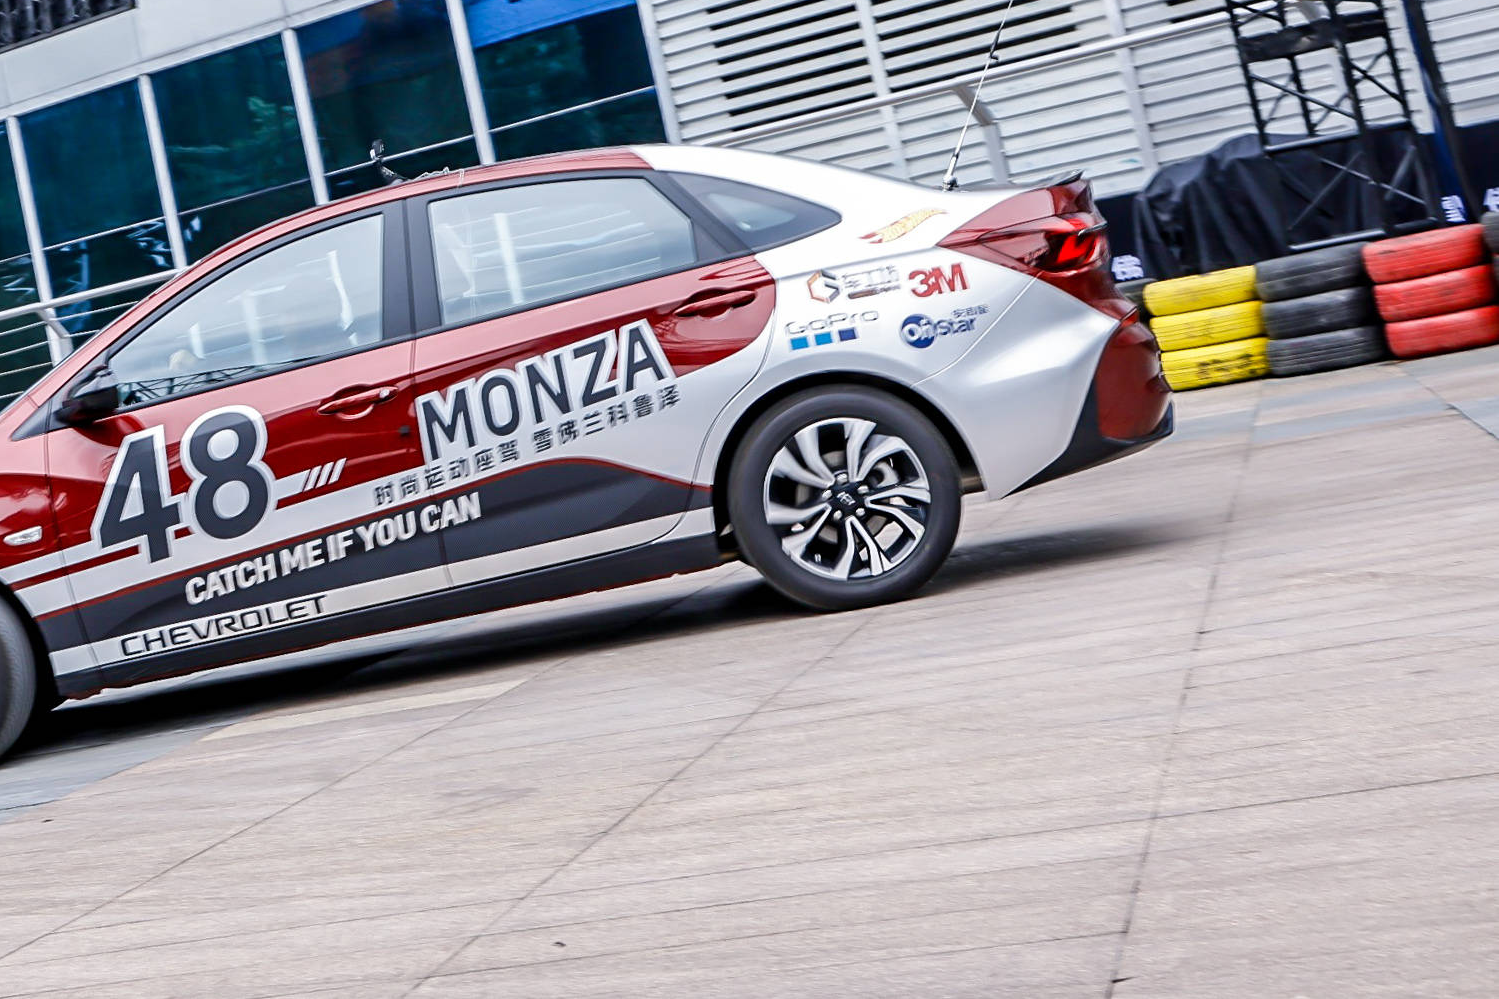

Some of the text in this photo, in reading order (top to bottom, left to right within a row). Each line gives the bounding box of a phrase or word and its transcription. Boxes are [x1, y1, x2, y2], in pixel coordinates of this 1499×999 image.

[784, 309, 880, 335] GoPro
[908, 262, 970, 297] 3M
[901, 315, 977, 344] OnStar
[420, 322, 672, 462] MONZA
[95, 407, 274, 563] 48
[374, 384, 682, 506] 时尚运动座驾 雪佛兰科鲁泽
[185, 491, 483, 606] CATCH ME IF YOU CAN
[119, 593, 328, 658] CHEVROLET
